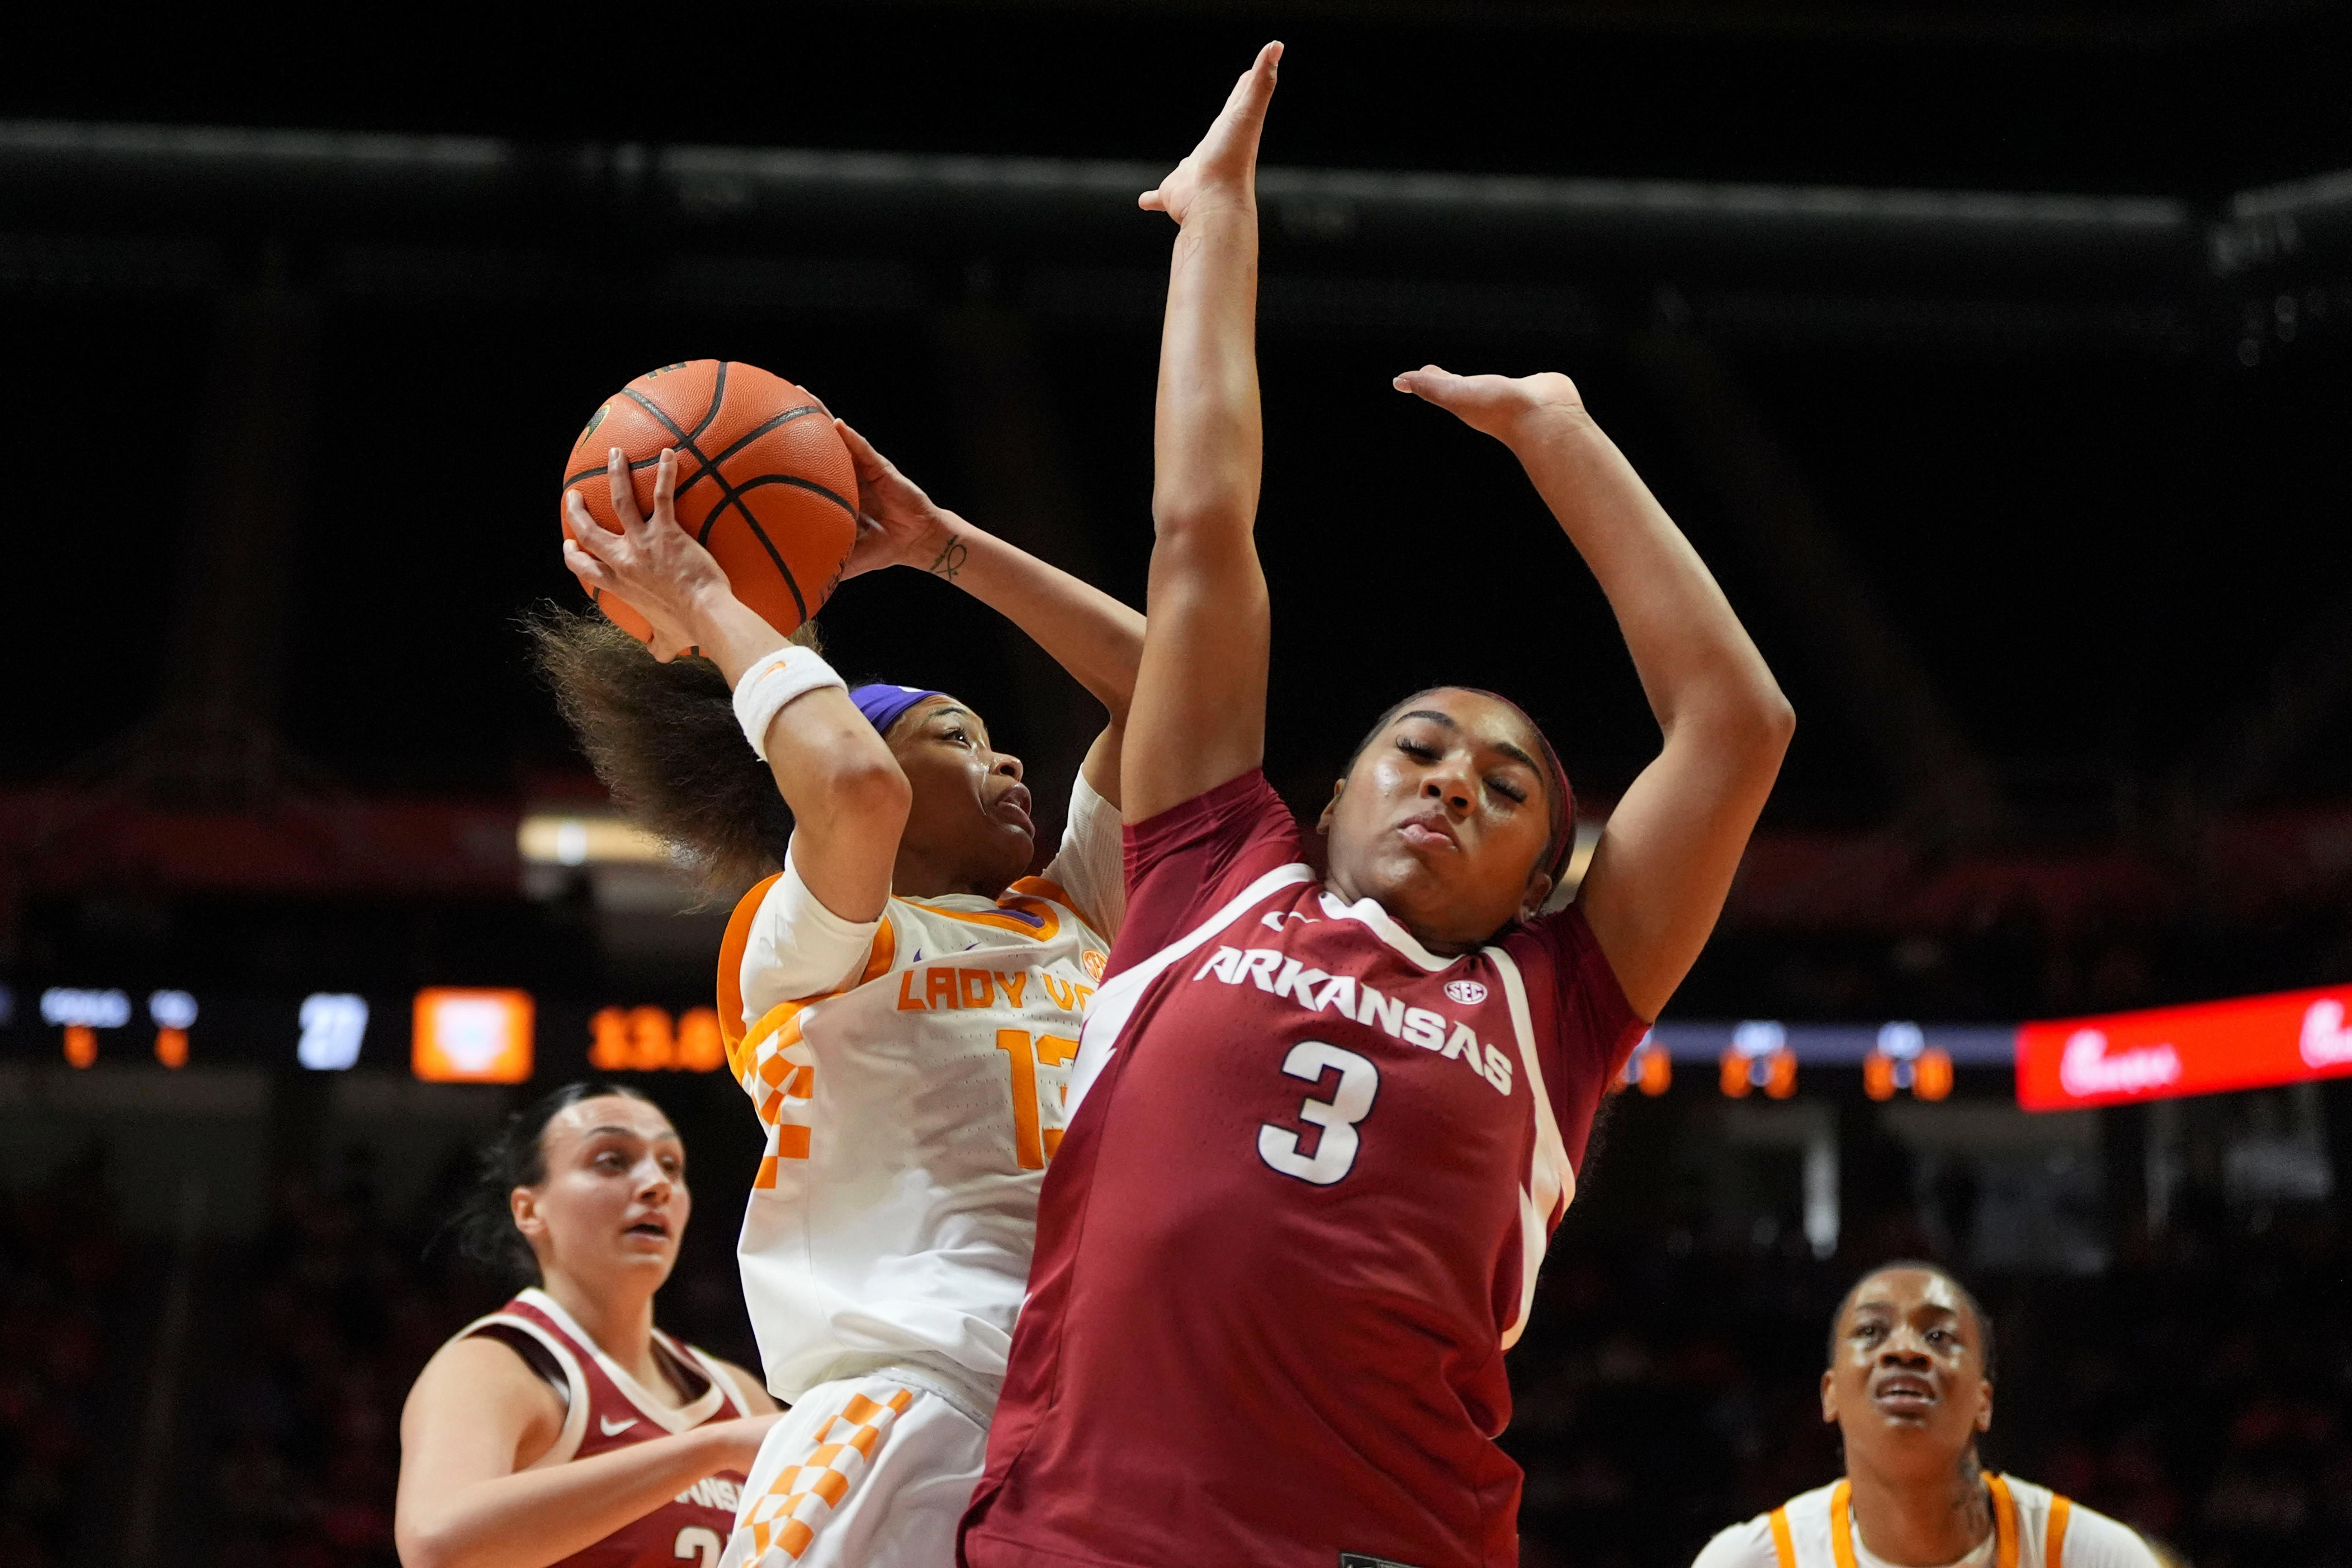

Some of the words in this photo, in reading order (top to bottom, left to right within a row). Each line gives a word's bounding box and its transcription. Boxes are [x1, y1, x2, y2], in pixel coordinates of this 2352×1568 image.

[897, 967, 1026, 1011] LADY
[1193, 945, 1513, 1096] ARKANSAS
[1446, 982, 1485, 1002] SEC
[1256, 1040, 1381, 1187] 3
